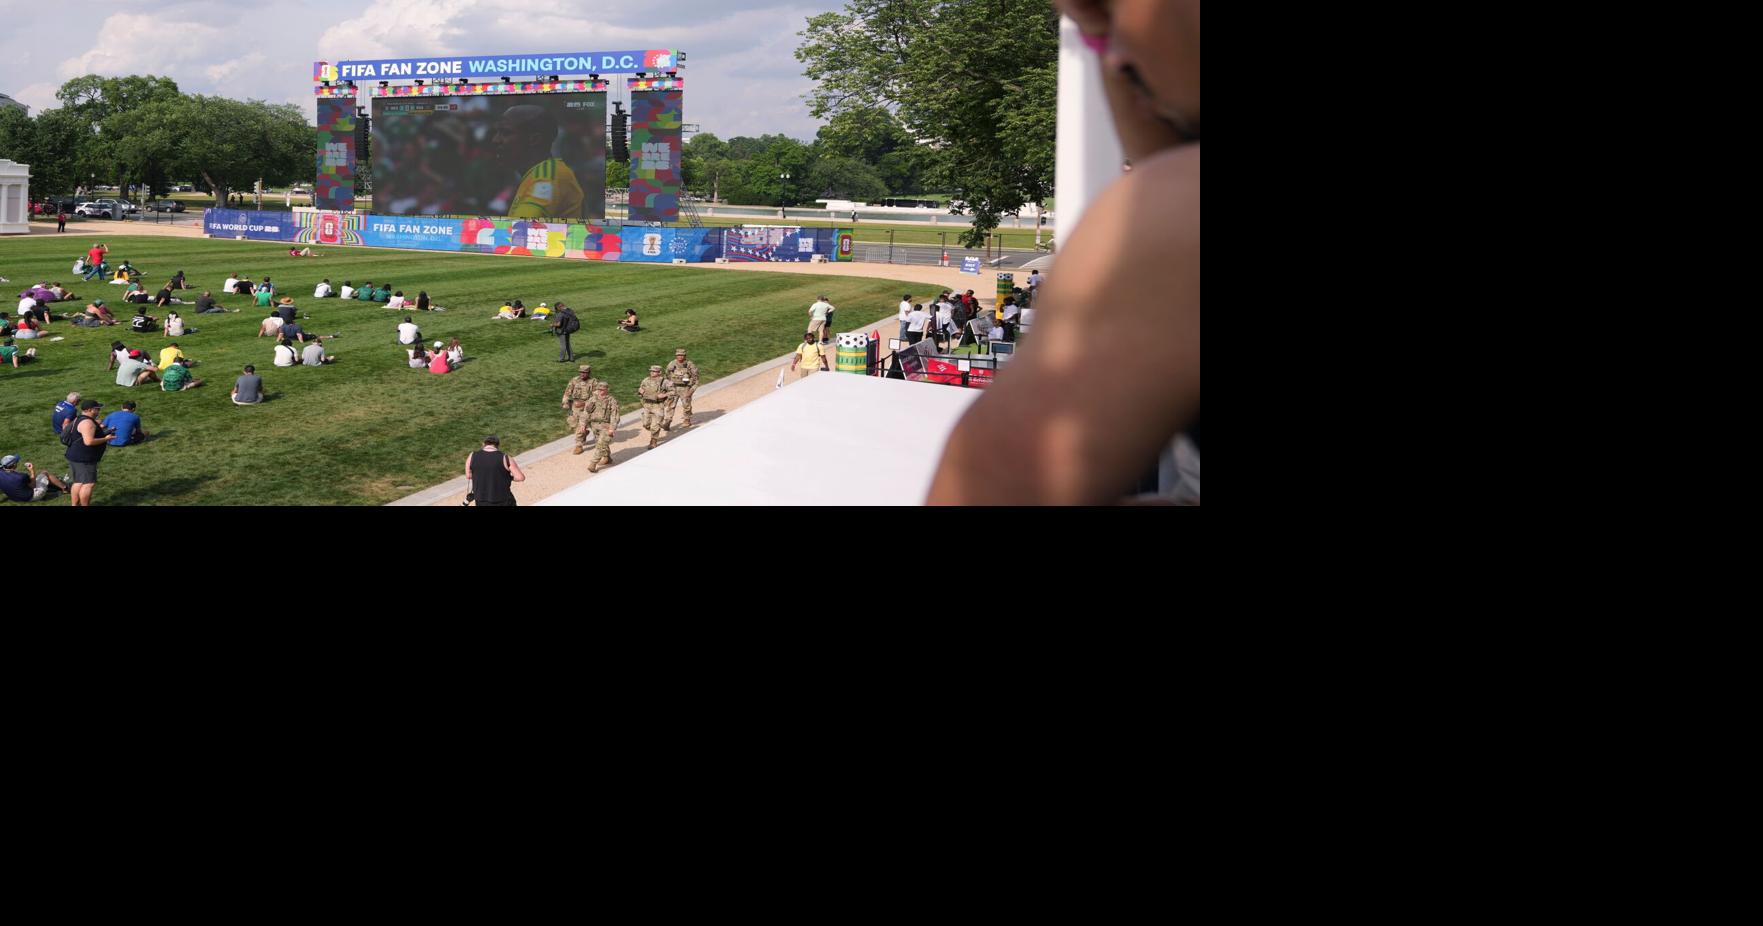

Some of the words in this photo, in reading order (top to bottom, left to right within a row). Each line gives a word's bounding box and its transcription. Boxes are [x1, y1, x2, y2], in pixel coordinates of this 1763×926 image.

[342, 64, 376, 77] FIFA
[380, 63, 412, 75] FAN
[416, 61, 463, 75] ZONE
[468, 56, 597, 73] WASHINGTON,
[602, 55, 639, 69] D.C.
[373, 223, 396, 233] FIFA
[400, 224, 420, 234] FAN
[423, 225, 453, 235] ZONE
